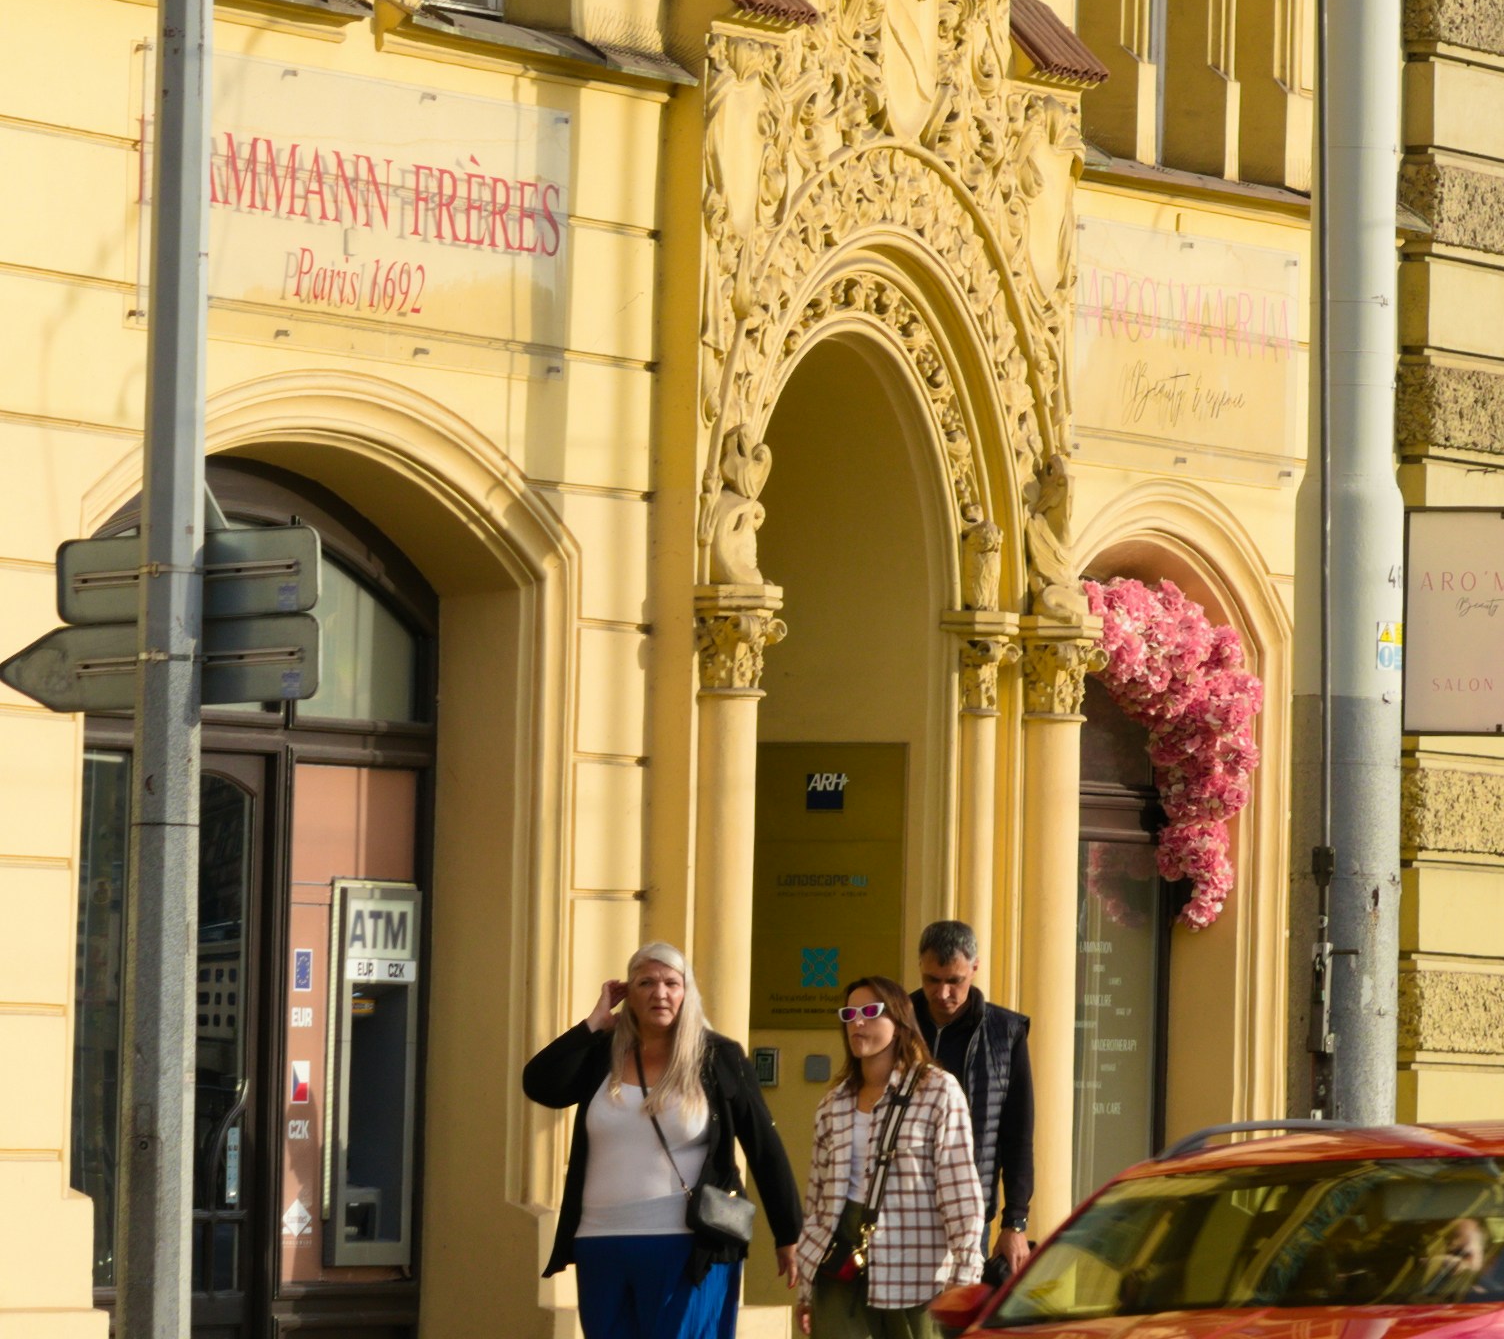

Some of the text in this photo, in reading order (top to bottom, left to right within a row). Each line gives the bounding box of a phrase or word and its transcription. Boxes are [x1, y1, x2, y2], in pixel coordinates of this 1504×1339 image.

[408, 154, 561, 258] FRÈRES
[292, 247, 427, 315] Paris 1692
[1455, 596, 1504, 617] Beauty
[1432, 678, 1493, 692] SALON
[350, 909, 408, 951] ATM
[357, 961, 405, 978] EUR CZK
[290, 1007, 313, 1027] EUR
[287, 1120, 309, 1139] CZK
